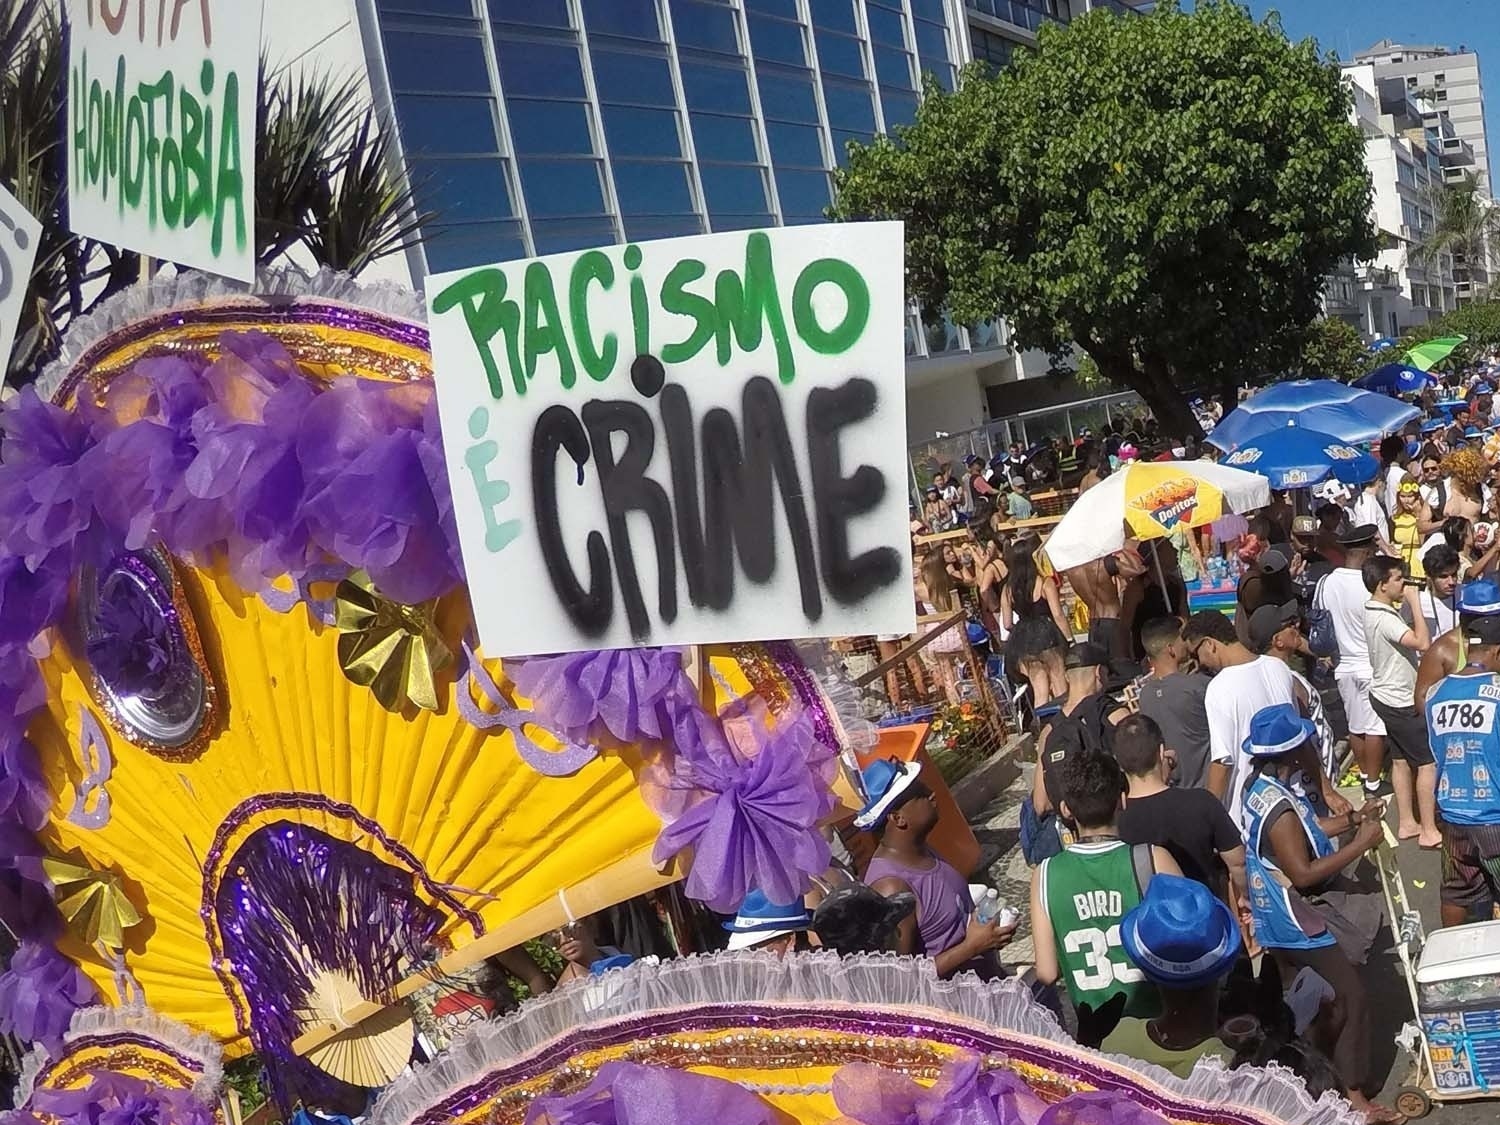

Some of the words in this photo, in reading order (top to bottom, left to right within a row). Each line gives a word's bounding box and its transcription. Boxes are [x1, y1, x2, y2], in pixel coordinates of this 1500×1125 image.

[1158, 495, 1197, 523] Doritos
[1436, 703, 1486, 729] 4786
[1073, 890, 1122, 921] BIRD
